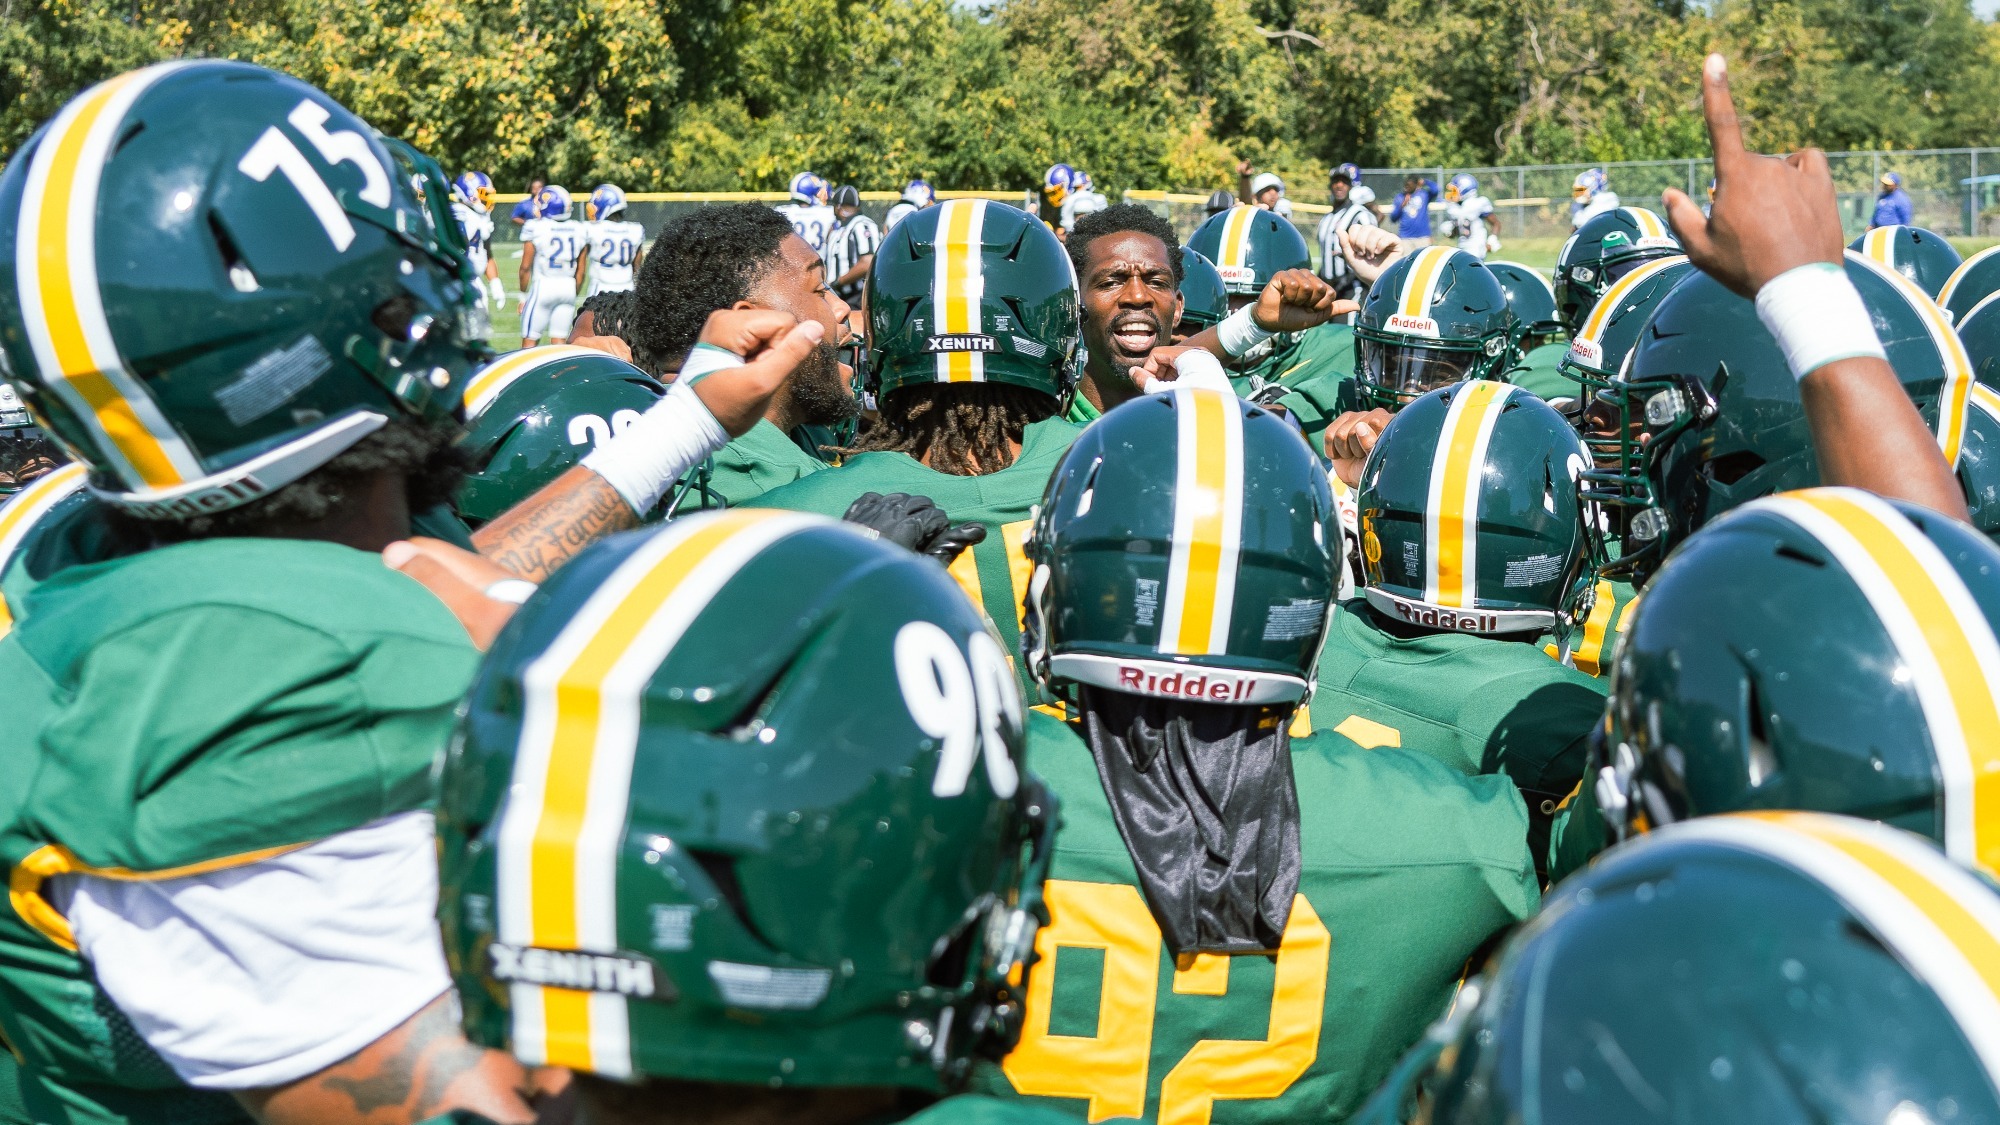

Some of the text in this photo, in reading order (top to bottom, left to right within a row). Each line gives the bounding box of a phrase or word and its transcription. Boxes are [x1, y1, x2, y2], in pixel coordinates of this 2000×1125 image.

[237, 98, 391, 253] 75
[549, 237, 575, 268] 21
[600, 238, 633, 267] 20
[1391, 316, 1432, 330] Riddell
[928, 337, 995, 350] XENITH
[1394, 600, 1497, 632] Riddell
[1118, 665, 1256, 701] Riddell
[487, 942, 655, 997] XENITH
